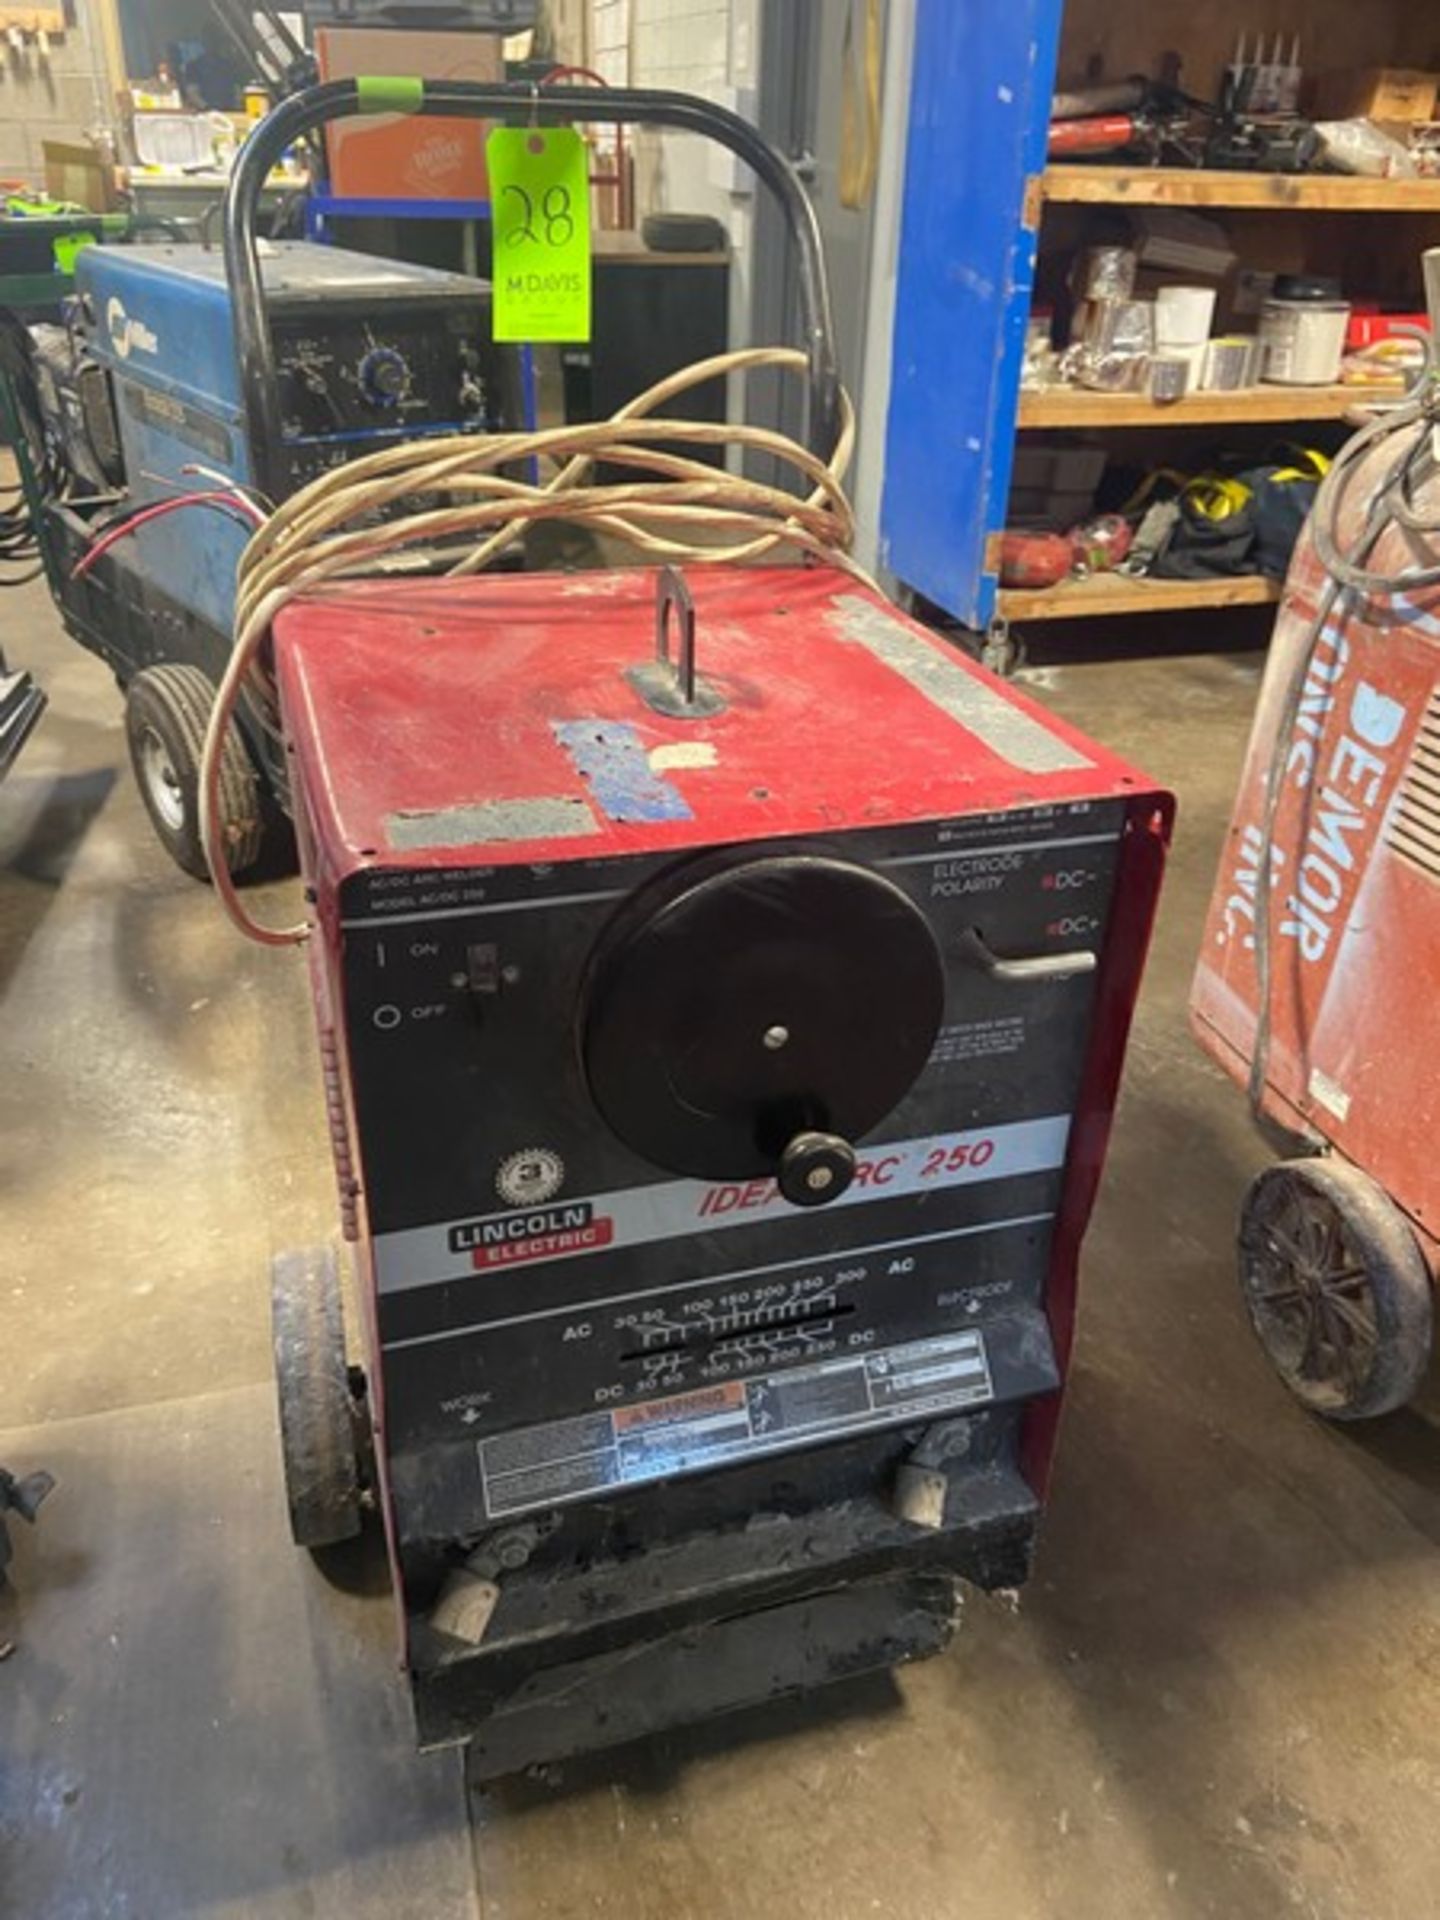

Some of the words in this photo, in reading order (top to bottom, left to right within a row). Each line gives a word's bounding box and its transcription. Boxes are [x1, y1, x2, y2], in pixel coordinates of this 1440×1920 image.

[502, 184, 574, 247] 28
[932, 855, 1024, 879] ELECTRODE
[931, 877, 1006, 898] POLARITY
[410, 943, 438, 958] ON
[412, 1004, 446, 1019] OFF
[920, 1139, 994, 1178] 250
[456, 1207, 584, 1248] LINCOLN
[487, 1228, 596, 1261] ELECTRIC
[562, 1322, 592, 1342] AC
[682, 1299, 714, 1315] 100
[754, 1283, 786, 1300] 200
[888, 1257, 915, 1275] AC
[594, 1384, 624, 1402] DC
[849, 1330, 875, 1346] DC
[440, 1391, 493, 1413] WORK
